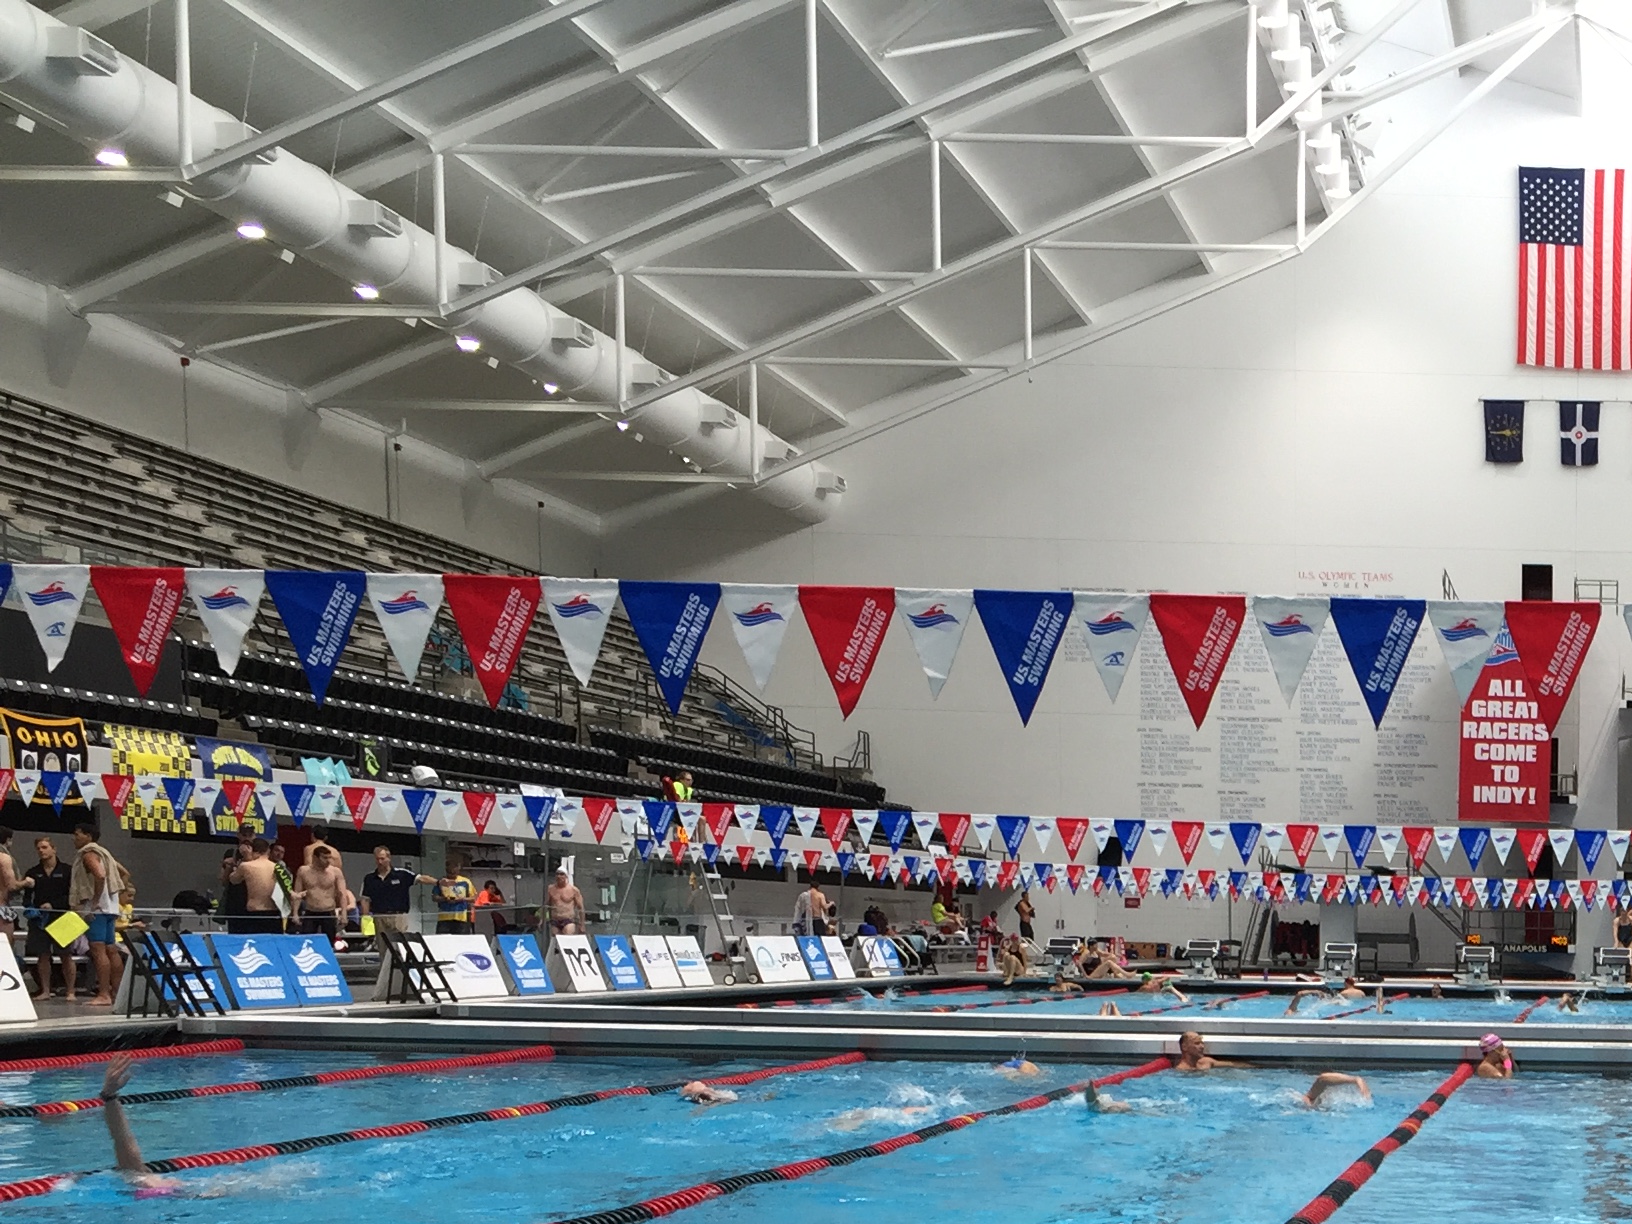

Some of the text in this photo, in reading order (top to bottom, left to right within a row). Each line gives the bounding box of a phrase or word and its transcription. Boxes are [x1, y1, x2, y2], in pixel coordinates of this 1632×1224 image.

[1362, 573, 1393, 582] TEAMS
[138, 578, 168, 643] MASTERS
[145, 589, 178, 664] SWIMMING
[316, 581, 347, 645] MASTERS
[321, 592, 356, 666] SWIMMING
[489, 587, 521, 651] MASTERS
[495, 598, 531, 673] SWIMMING
[667, 593, 701, 657] MASTERS
[673, 604, 710, 678] SWIMMING
[844, 598, 877, 662] MASTERS
[1022, 600, 1055, 664] MASTERS
[1193, 607, 1227, 670] MASTERS
[1375, 607, 1408, 671] MASTERS
[850, 609, 886, 683] SWIMMING
[1028, 611, 1064, 686] SWIMMING
[1199, 618, 1236, 691] SWIMMING
[1380, 618, 1417, 689] SWIMMING
[1547, 611, 1582, 675] MASTERS
[1552, 620, 1591, 697] SWIMMING
[1471, 700, 1538, 719] GREAT
[1488, 678, 1526, 697] ALL
[1462, 720, 1549, 741] RACERS
[1474, 743, 1537, 762] COME
[1473, 785, 1536, 805] INDY!
[1491, 765, 1520, 783] TO
[564, 947, 598, 977] TYR
[1503, 944, 1548, 953] ANAPOLIS
